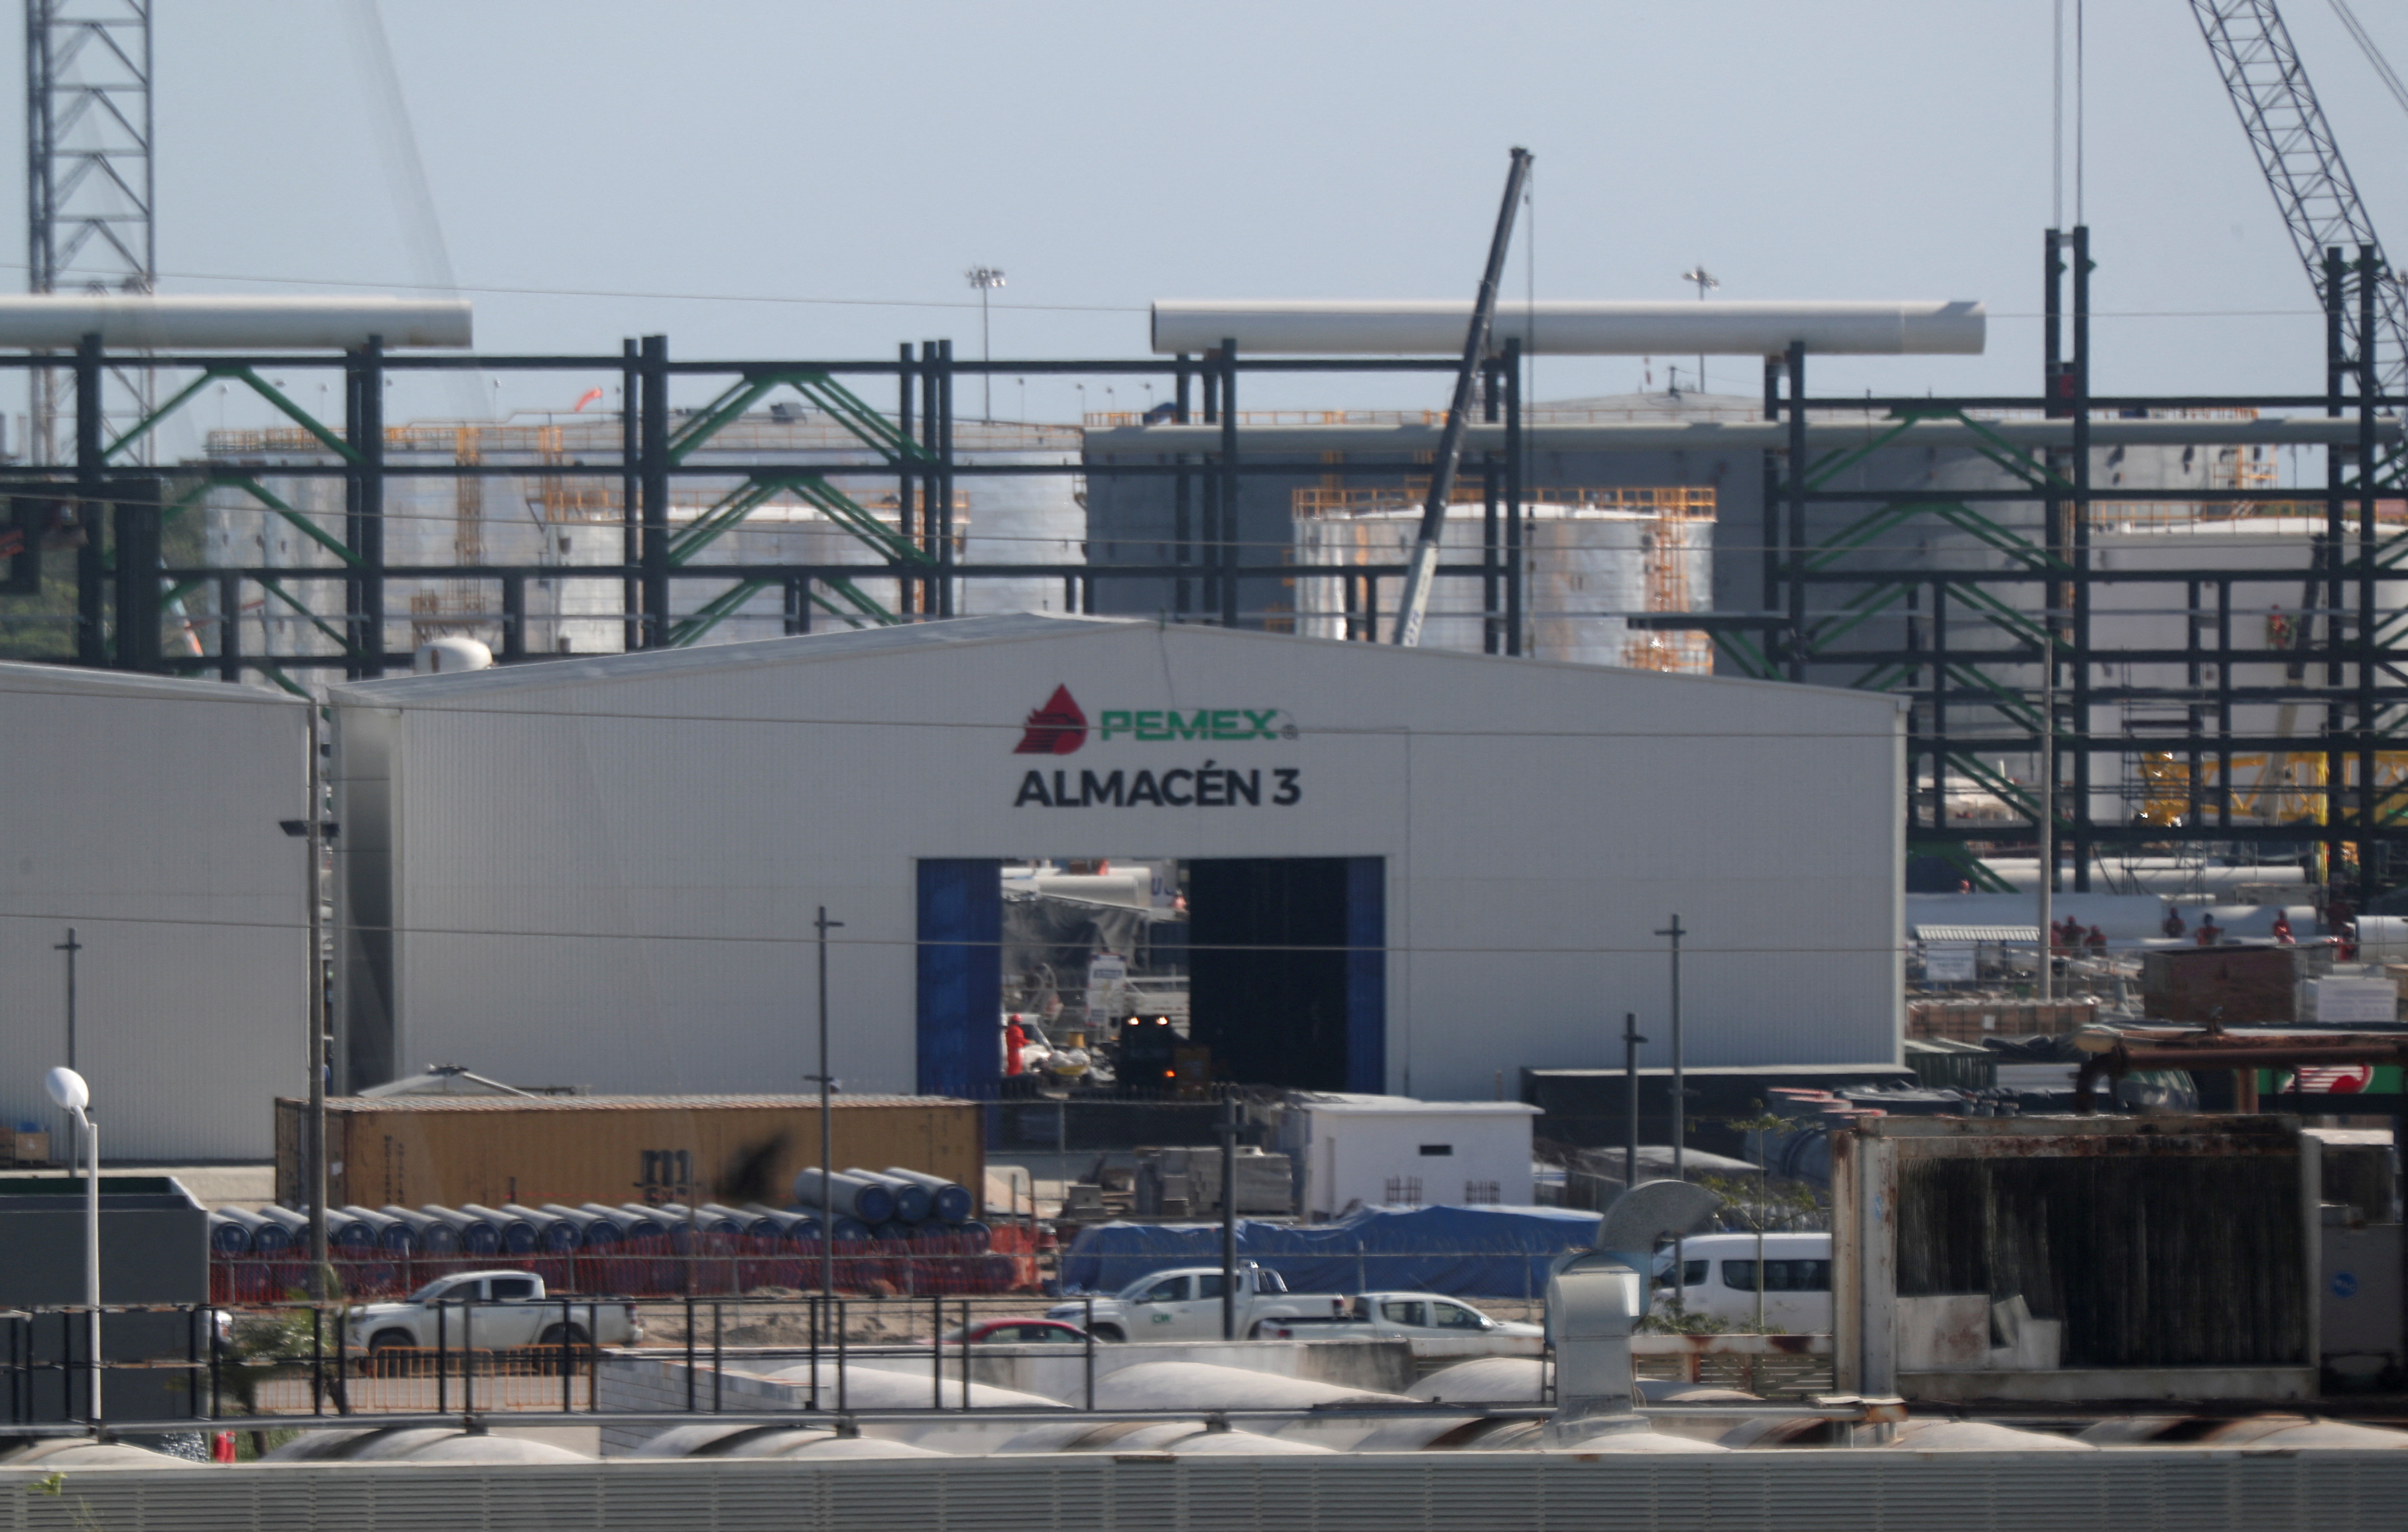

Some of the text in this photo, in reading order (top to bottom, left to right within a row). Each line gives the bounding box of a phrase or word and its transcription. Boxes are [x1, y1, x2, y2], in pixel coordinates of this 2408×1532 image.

[1101, 709, 1278, 741] PEMEX
[1013, 759, 1302, 807] ALMACÉN 3
